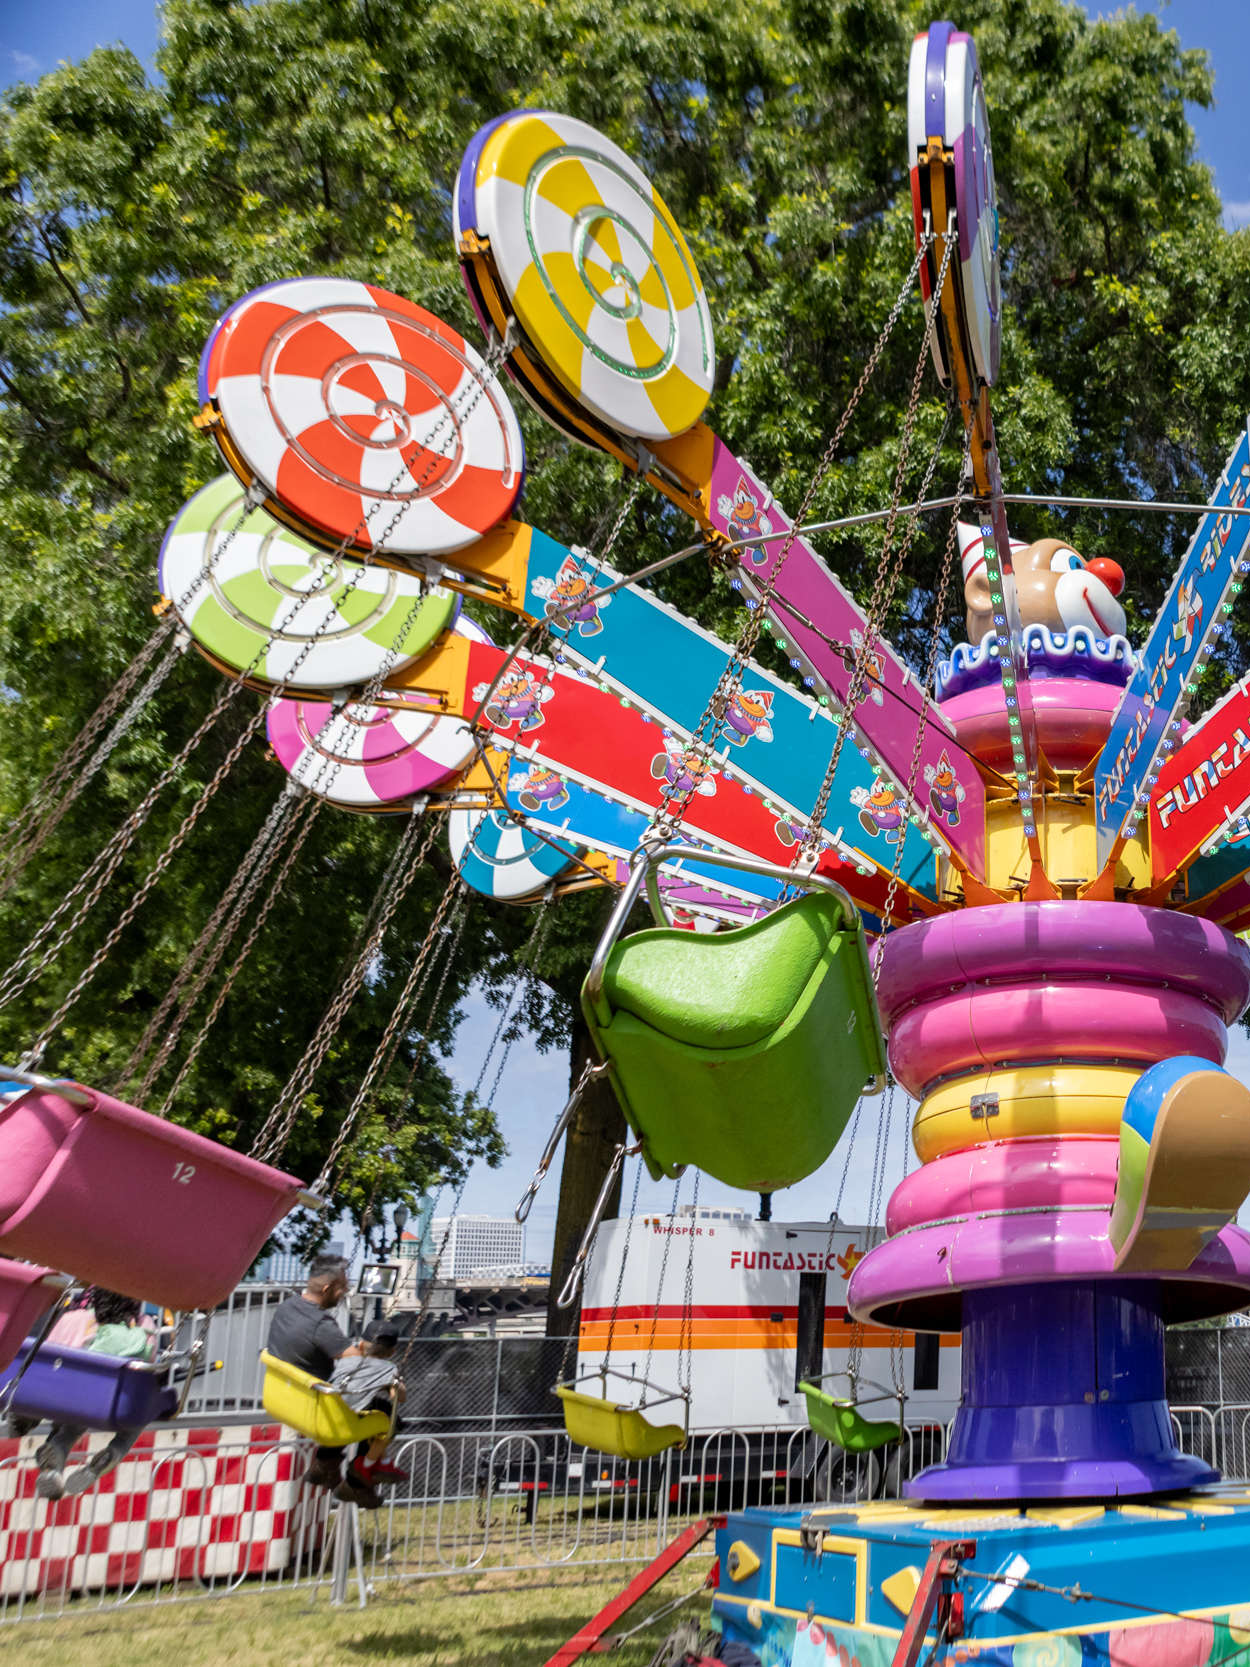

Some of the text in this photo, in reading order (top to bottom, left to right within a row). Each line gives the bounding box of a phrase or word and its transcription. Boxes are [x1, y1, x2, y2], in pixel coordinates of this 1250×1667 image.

[172, 1161, 196, 1185] 12
[653, 1226, 715, 1236] WHISPER 8
[731, 1251, 837, 1271] FUNTASTIC
